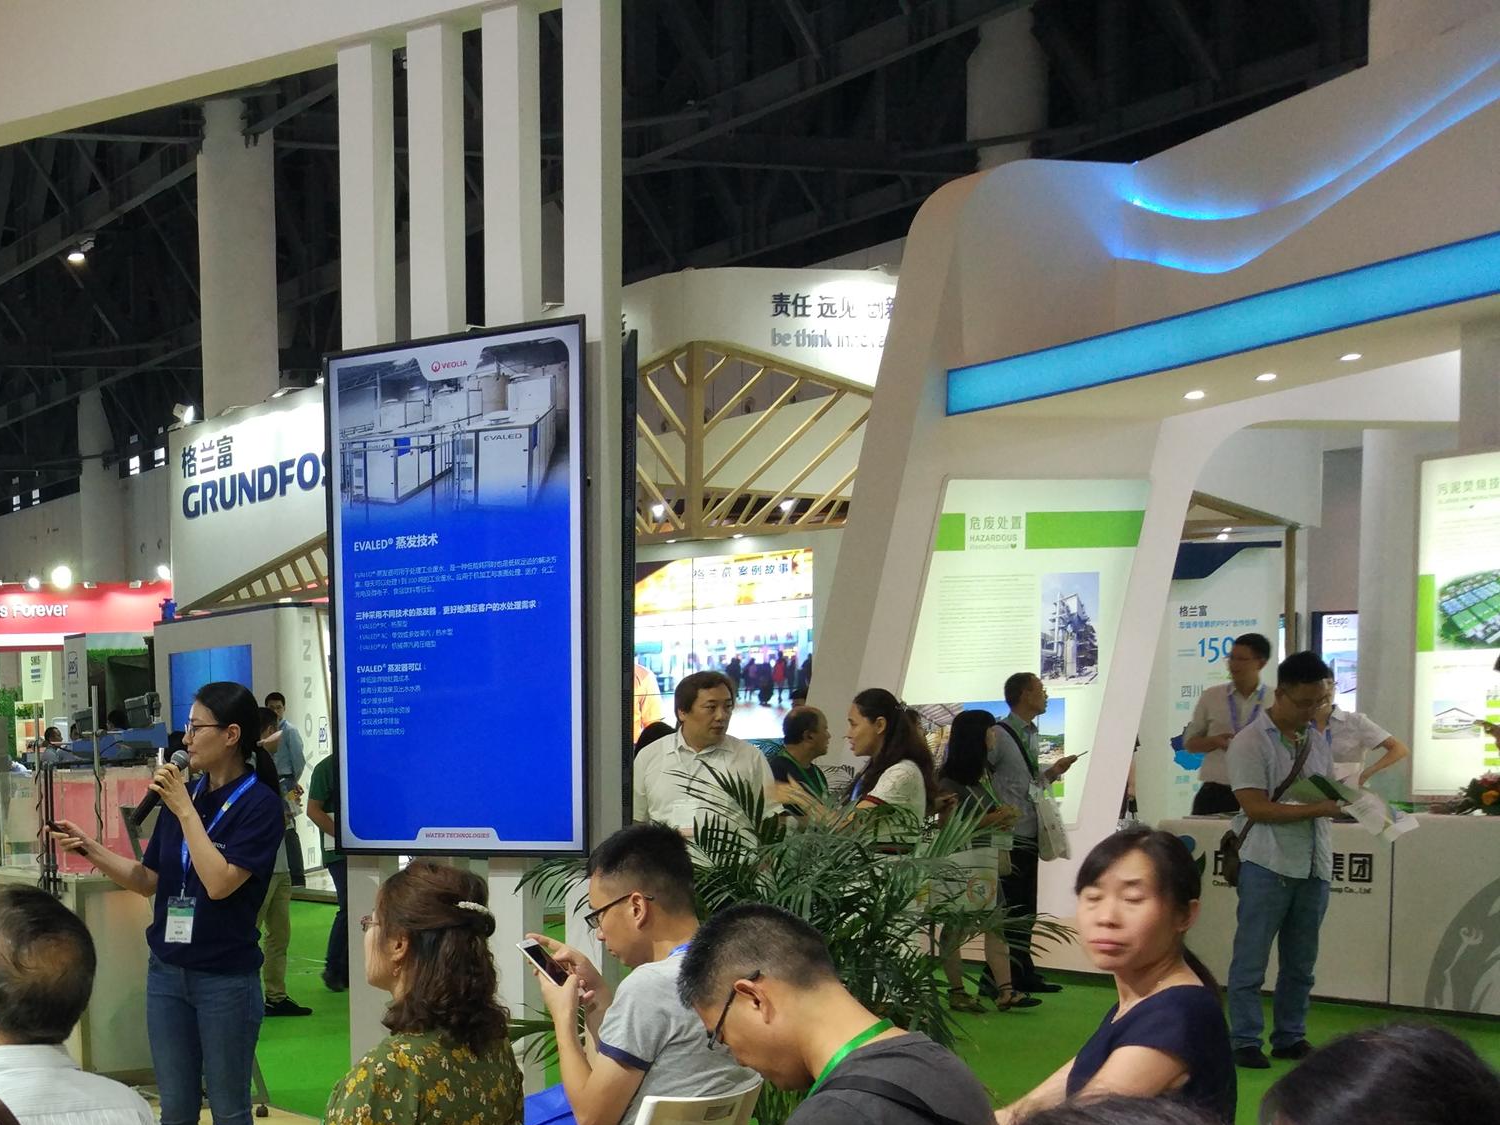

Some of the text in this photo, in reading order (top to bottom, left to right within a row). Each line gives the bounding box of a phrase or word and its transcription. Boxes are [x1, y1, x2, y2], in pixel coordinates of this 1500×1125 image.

[771, 292, 812, 318] 责任
[817, 295, 857, 319] 远见
[771, 327, 792, 347] be
[794, 328, 832, 348] think
[441, 360, 468, 369] VEOLIA
[483, 432, 523, 441] EVALED
[181, 434, 234, 479] 格兰富
[182, 452, 326, 520] GRUNDFO
[969, 514, 1022, 530] 危废处置
[395, 532, 439, 550] 蒸发技术
[969, 534, 1018, 542] HAZARDOUS
[13, 603, 69, 618] Forever
